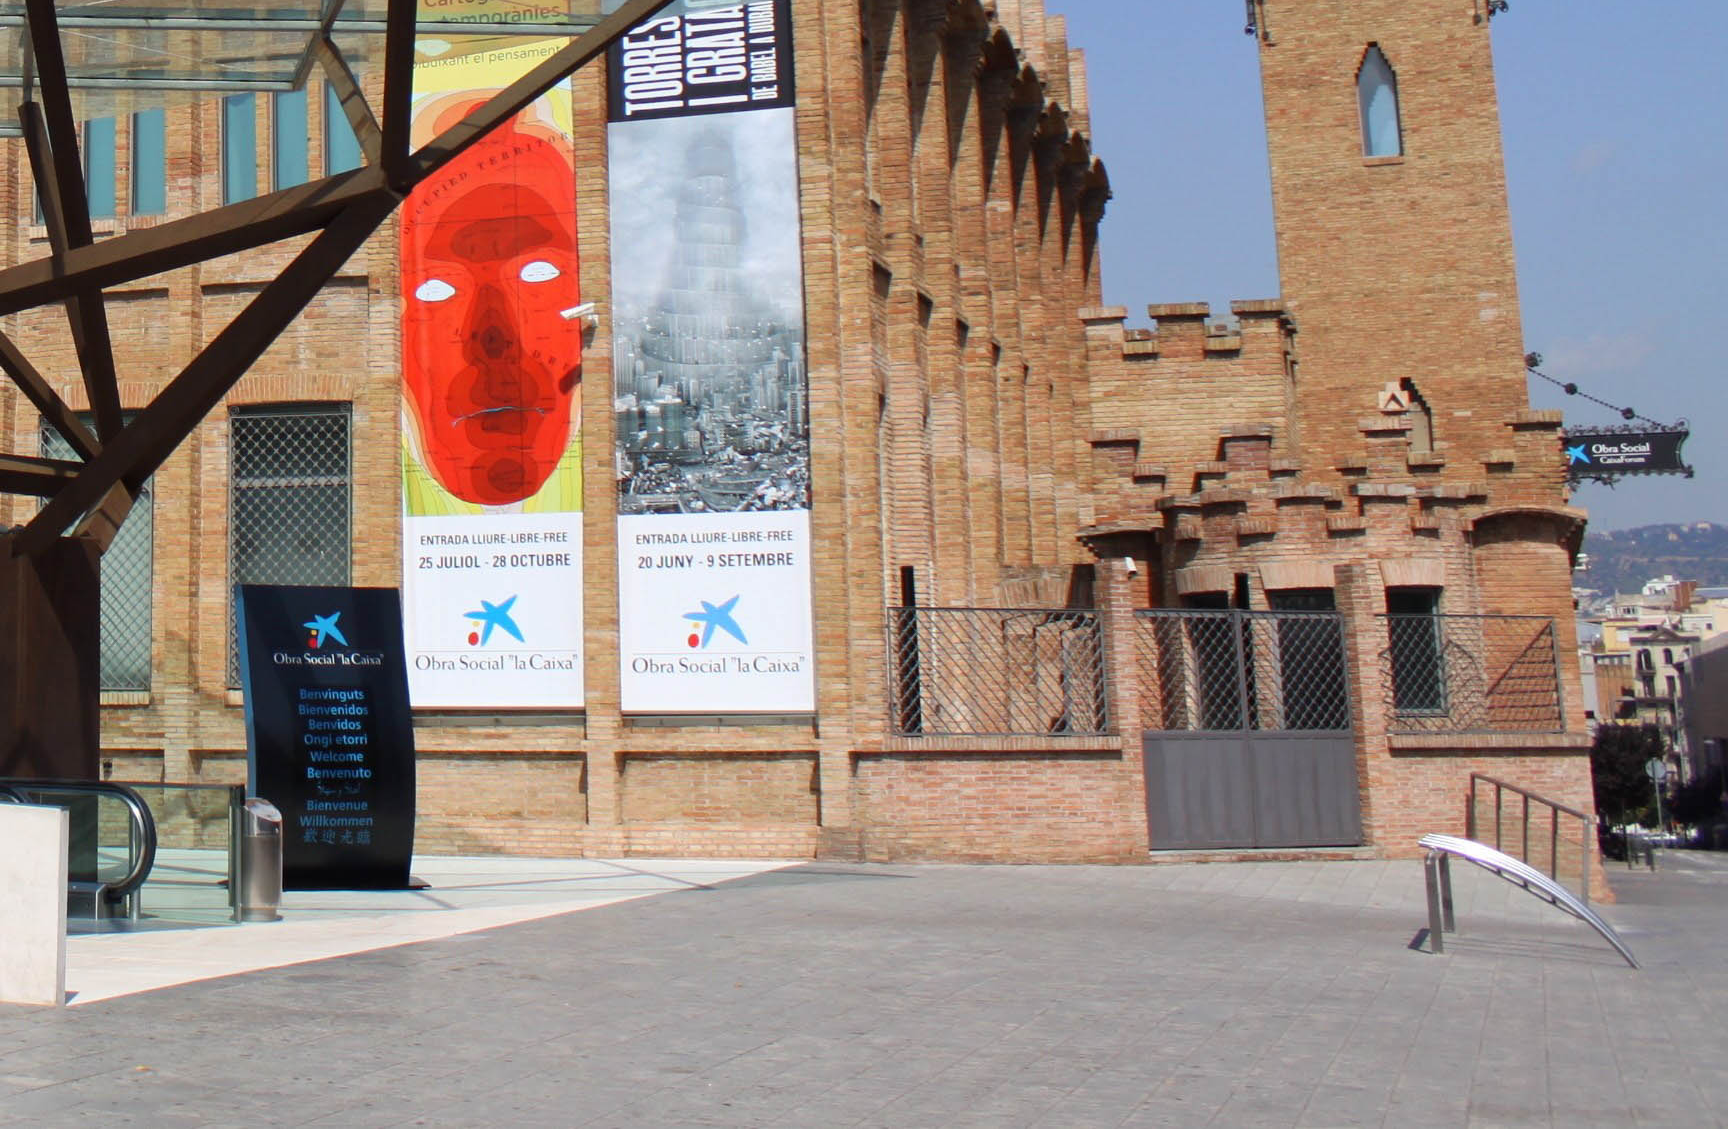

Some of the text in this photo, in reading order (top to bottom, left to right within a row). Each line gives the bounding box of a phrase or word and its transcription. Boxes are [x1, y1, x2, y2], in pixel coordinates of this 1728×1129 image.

[623, 15, 685, 116] TORRES
[750, 47, 777, 82] BABEL
[751, 84, 778, 100] DE
[1592, 442, 1650, 454] Obra Social
[420, 534, 469, 546] ENTRADA
[636, 534, 688, 544] ENTRADA
[419, 557, 433, 569] 25
[436, 556, 480, 568] JULIOL
[492, 555, 506, 568] 28
[510, 554, 572, 567] OCTUBRE
[638, 556, 653, 568] 20
[656, 555, 694, 568] JUNY
[707, 555, 715, 568] 9
[718, 552, 794, 567] SETEMBRE
[274, 652, 302, 665] Obra
[304, 652, 336, 665] Social
[415, 655, 455, 670] Obra
[459, 654, 504, 670] Social
[632, 658, 674, 674] Obra
[678, 657, 726, 674] Social
[299, 688, 365, 702] Benvinguts
[298, 704, 368, 716] Bienvenidos
[308, 718, 362, 730] Benvidos
[336, 734, 368, 745] etorri
[310, 751, 364, 762] Welcome
[307, 766, 372, 778] Benvenuto
[306, 800, 368, 810] Bienvenue
[300, 815, 373, 827] Willkommen
